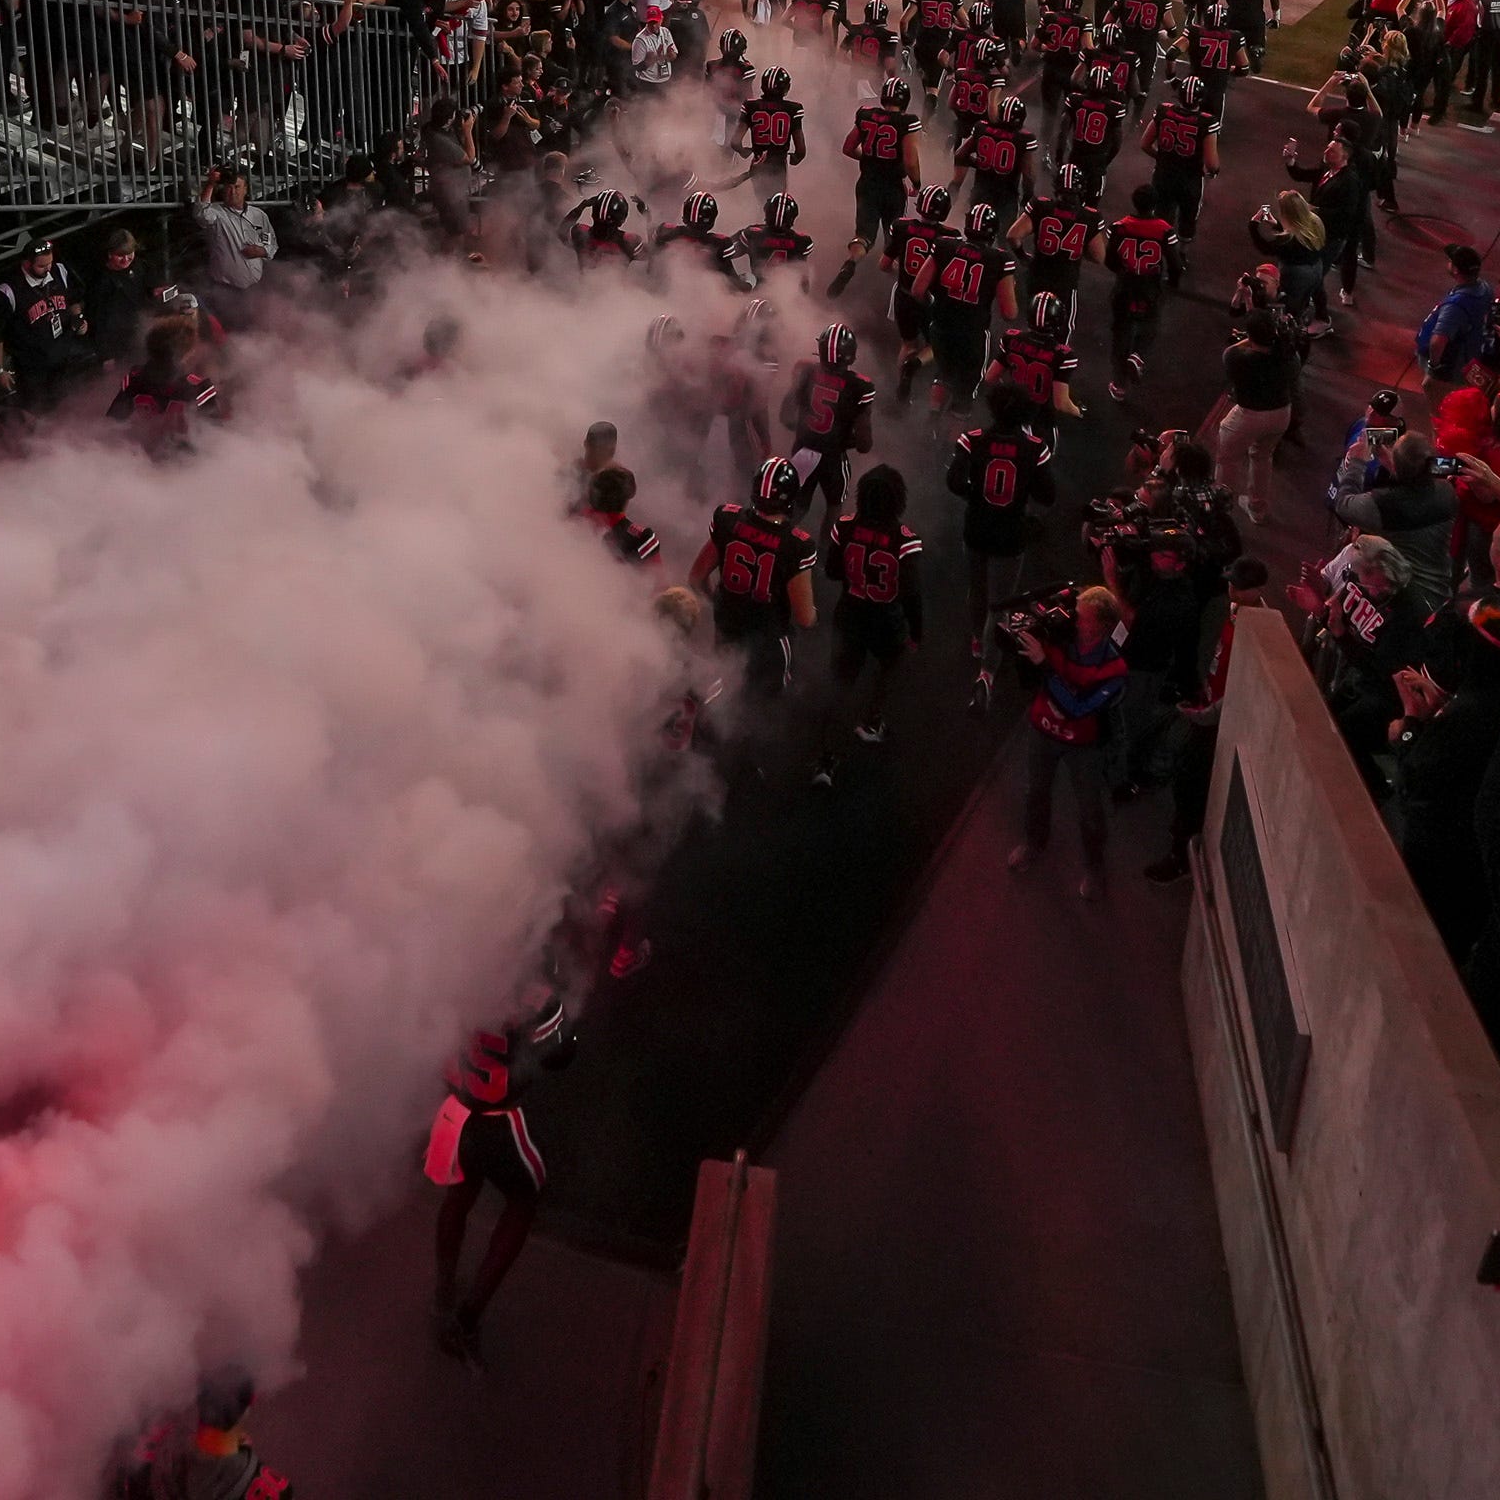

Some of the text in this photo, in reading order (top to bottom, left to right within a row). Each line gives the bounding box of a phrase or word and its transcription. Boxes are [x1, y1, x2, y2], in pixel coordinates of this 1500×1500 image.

[922, 1, 953, 28] 56
[1125, 1, 1158, 29] 78
[1046, 24, 1079, 52] 34
[1200, 38, 1229, 69] 71
[956, 80, 989, 115] 83
[751, 111, 791, 146] 20
[860, 120, 898, 159] 72
[1076, 108, 1107, 144] 18
[1159, 120, 1197, 156] 65
[977, 135, 1016, 175] 90
[1039, 216, 1087, 261] 64
[1117, 239, 1161, 275] 42
[941, 256, 984, 303] 41
[808, 385, 839, 434] 5
[983, 458, 1016, 507] 0
[722, 541, 775, 602] 61
[844, 543, 898, 603] 43
[1343, 581, 1385, 644] THE
